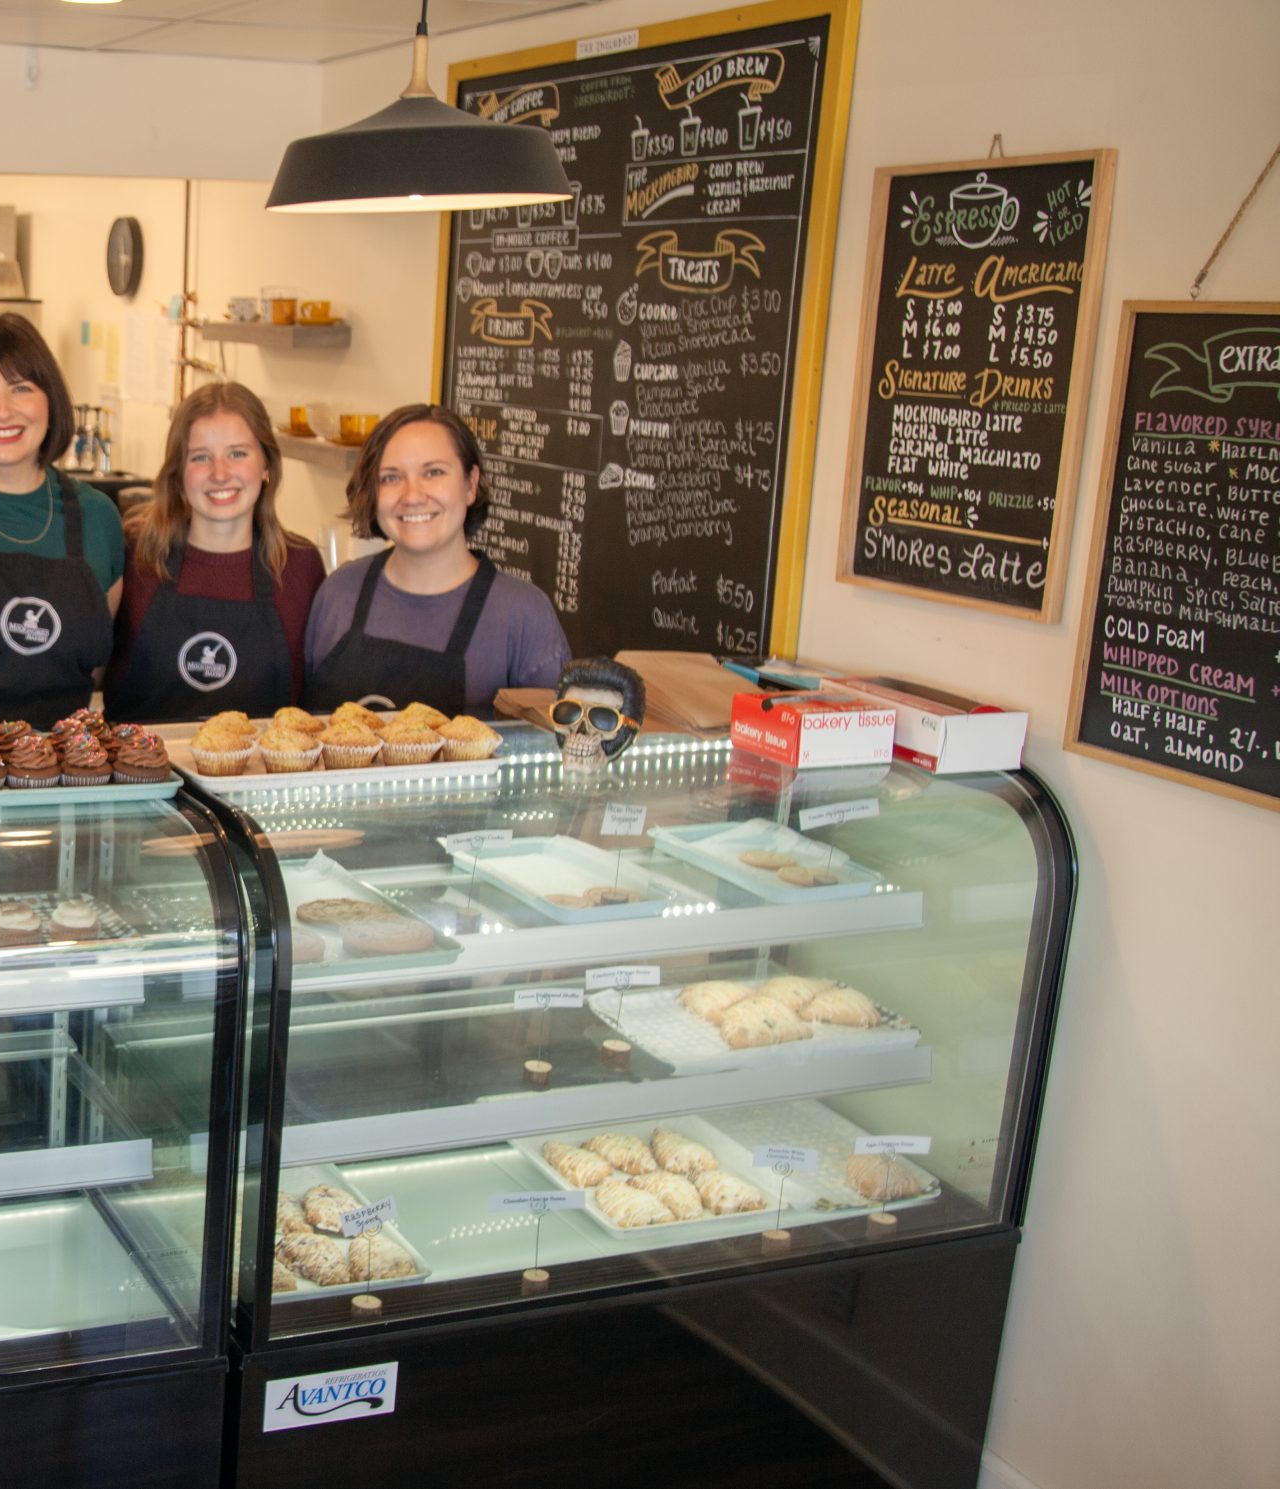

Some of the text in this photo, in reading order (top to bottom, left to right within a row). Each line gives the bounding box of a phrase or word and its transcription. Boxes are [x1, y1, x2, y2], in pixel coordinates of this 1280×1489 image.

[686, 64, 722, 99] COLD
[1046, 180, 1071, 212] HOT
[905, 298, 917, 321] S
[927, 299, 963, 318] $5.00
[993, 303, 1006, 326] S
[901, 319, 1060, 349] M $6.00 M $4.50
[902, 339, 1055, 370] L $7.00 L $5.50
[1104, 614, 1150, 645] COLD
[1100, 671, 1143, 700] MILK
[735, 719, 788, 750] bakery tissue
[803, 711, 895, 733] bakery tissue
[325, 1367, 388, 1386] REFRIGERATION
